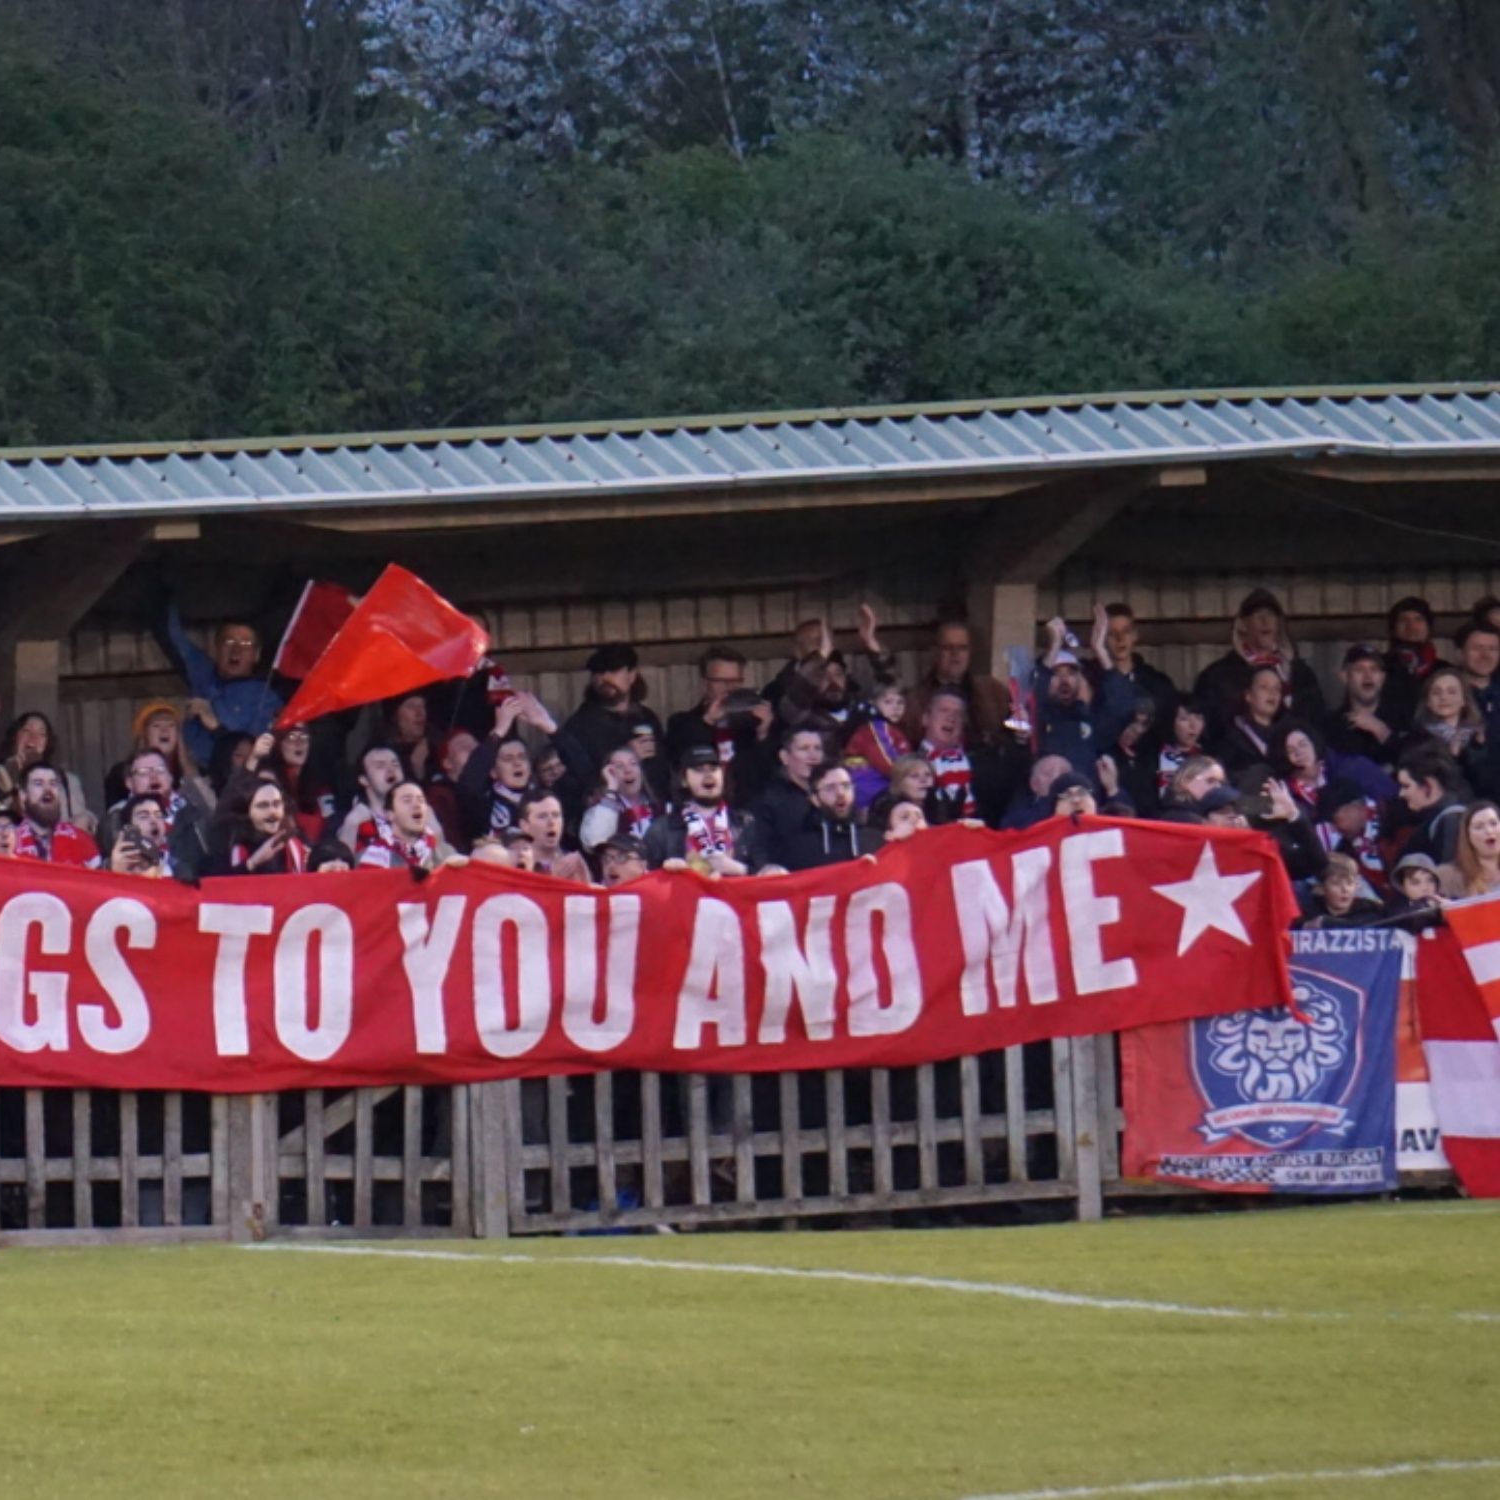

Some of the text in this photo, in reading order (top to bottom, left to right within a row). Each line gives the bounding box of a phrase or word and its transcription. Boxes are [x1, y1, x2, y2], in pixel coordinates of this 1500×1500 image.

[198, 902, 354, 1062] TO
[397, 894, 641, 1058] YOU
[673, 882, 923, 1049] AND
[951, 828, 1139, 1016] ME
[1289, 929, 1403, 953] IRAZZISTA
